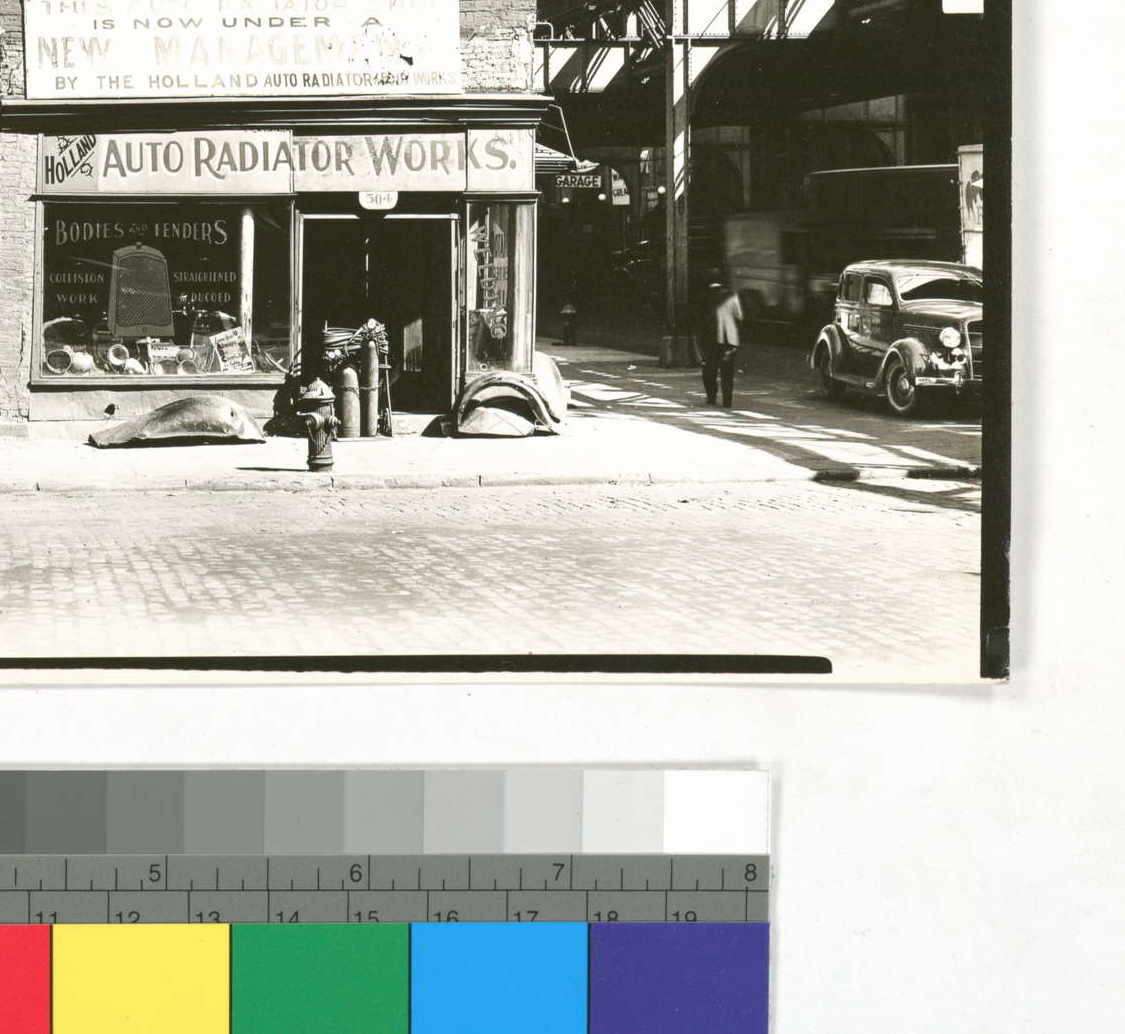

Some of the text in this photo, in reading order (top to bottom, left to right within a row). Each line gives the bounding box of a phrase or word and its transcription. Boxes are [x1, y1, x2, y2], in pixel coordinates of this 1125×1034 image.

[41, 0, 114, 15] THIS
[93, 16, 383, 30] IS NOW UNDER A
[37, 36, 112, 69] NEW
[55, 76, 77, 90] BY
[96, 75, 134, 89] THE
[149, 73, 258, 89] HOLLAND
[264, 73, 298, 87] AUTO
[303, 72, 372, 88] RADIATOR
[414, 71, 457, 86] WORKS
[45, 135, 517, 184] HOLLAND AUTO RADIATOR WORKS.
[556, 175, 599, 187] GARAGE
[366, 193, 393, 206] 504
[56, 219, 125, 246] BODIES
[154, 220, 228, 245] FENDERS
[49, 272, 104, 284] COLLISION
[173, 271, 237, 283] STRAIGHTENED
[56, 293, 98, 304] WORK
[191, 292, 231, 303] DUCOED
[148, 863, 161, 882] 5
[349, 863, 363, 882] 6
[552, 863, 565, 882] 7
[744, 863, 757, 882] 8
[35, 911, 58, 924] 11
[115, 911, 141, 924] 12
[195, 911, 221, 923] 13
[275, 911, 300, 923] 14
[354, 911, 379, 923] 15
[433, 911, 459, 923] 16
[513, 911, 539, 923] 17
[593, 911, 619, 923] 18
[672, 911, 697, 923] 19
